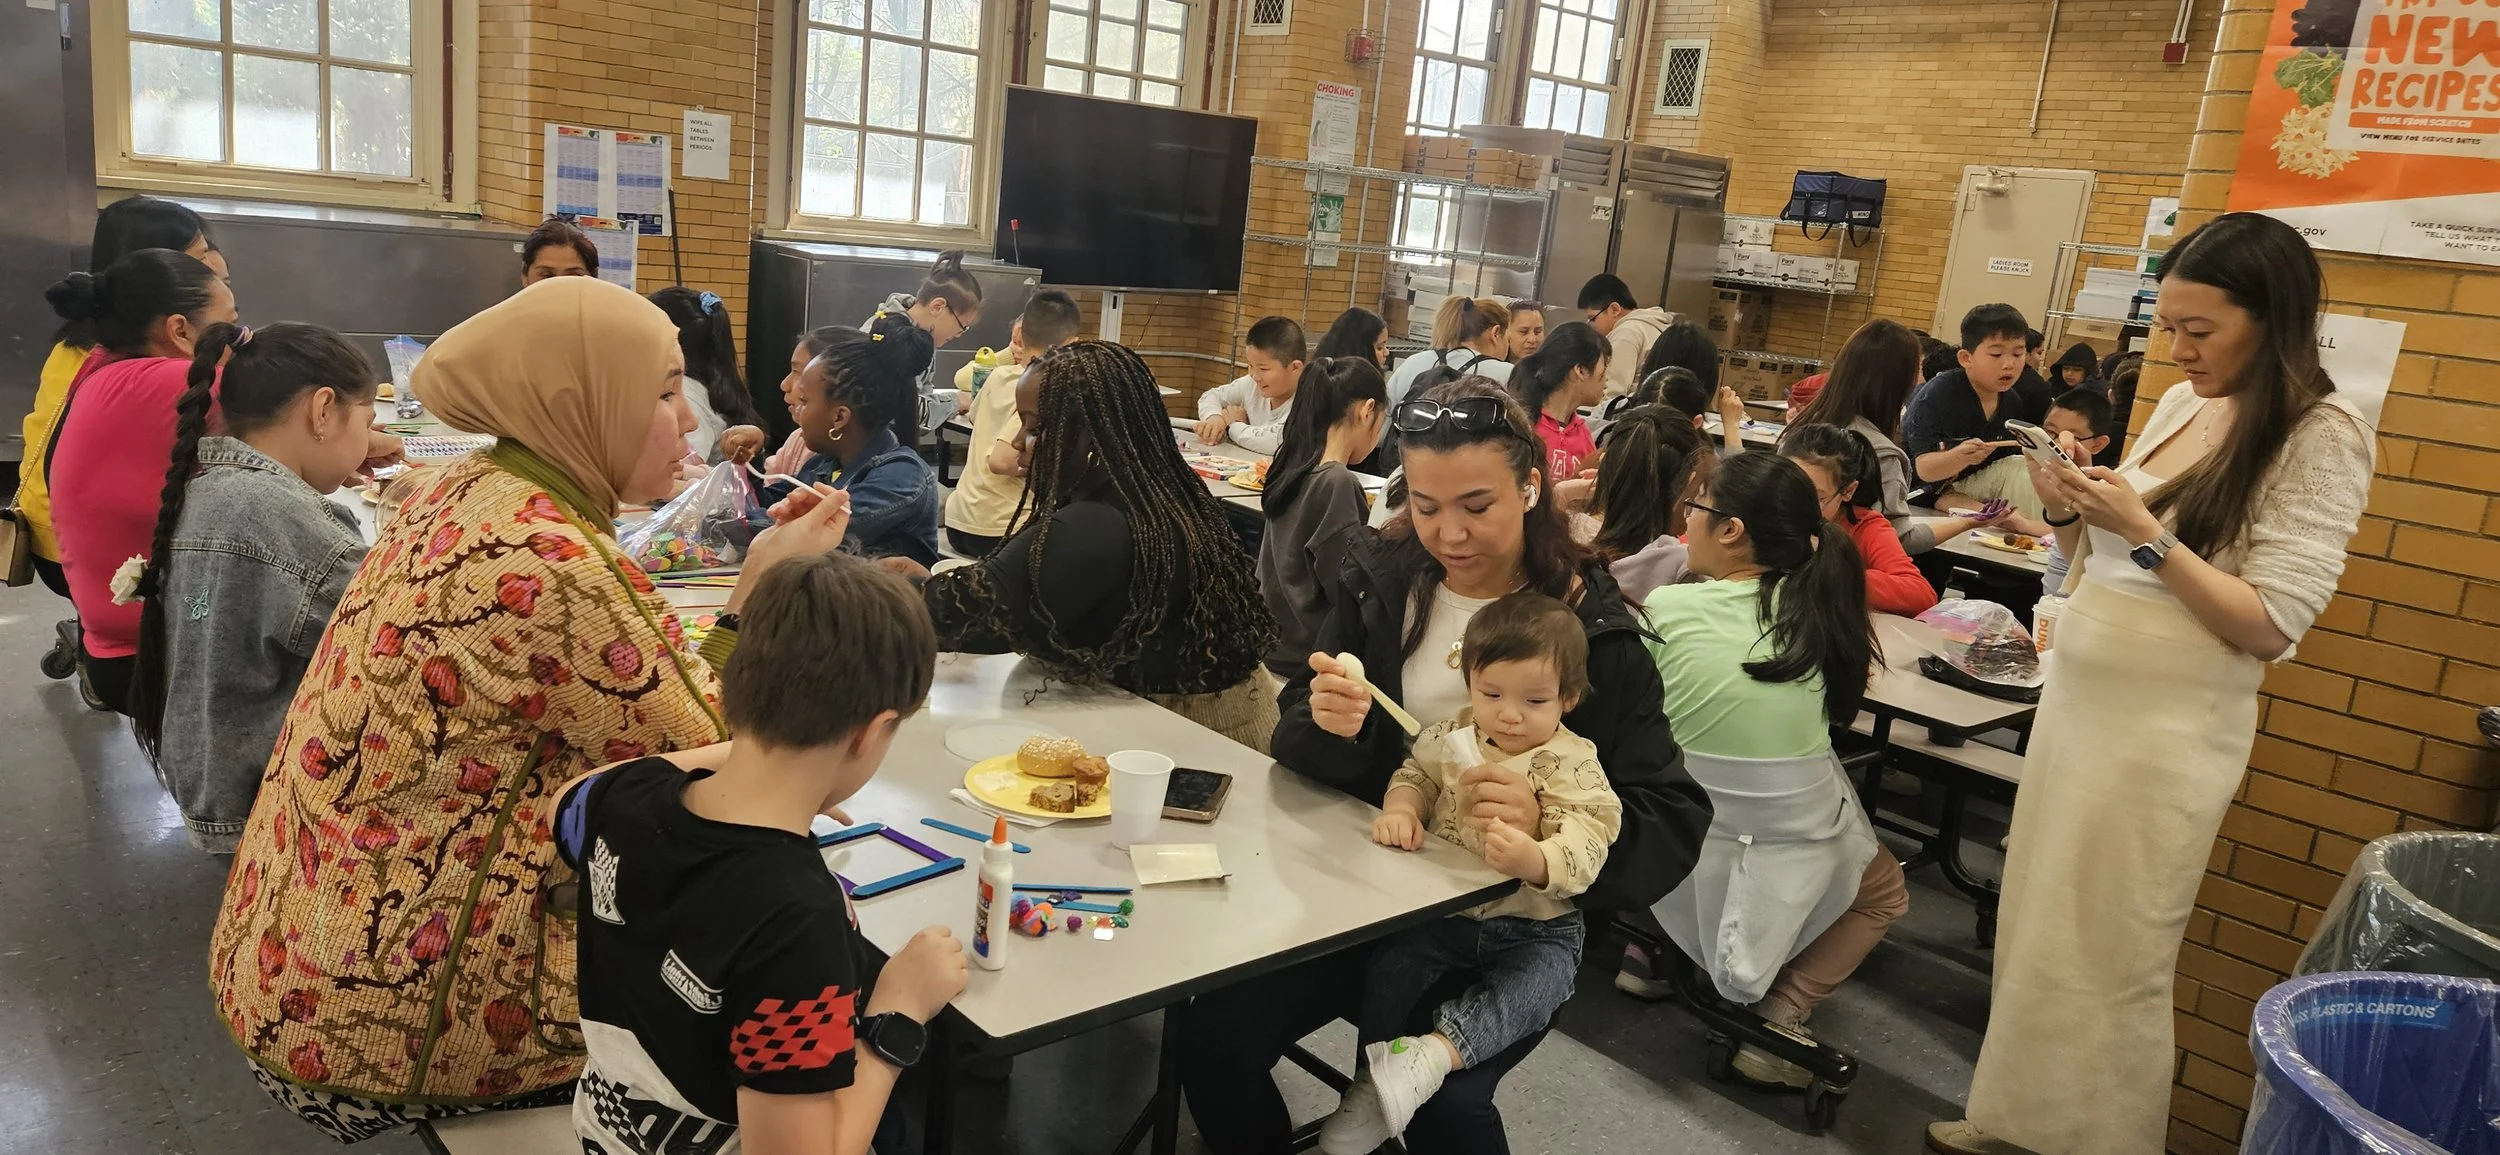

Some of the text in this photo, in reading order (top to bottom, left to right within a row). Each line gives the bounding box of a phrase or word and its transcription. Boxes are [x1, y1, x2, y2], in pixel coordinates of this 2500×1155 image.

[2365, 14, 2500, 68] NEW
[1317, 83, 1354, 97] CHOKING
[2351, 68, 2500, 112] RECIPES
[2421, 136, 2454, 144] SERVICE
[2410, 221, 2434, 229] TAKE
[2445, 224, 2474, 232] QUICK
[2425, 231, 2446, 239] TELL
[2463, 234, 2492, 242] WHAT
[2445, 241, 2474, 250] WANT
[2318, 336, 2336, 349] LL
[2310, 1003, 2354, 1019] PLASTIC
[2355, 1003, 2364, 1014] &
[2366, 1002, 2437, 1019] CARTONS
